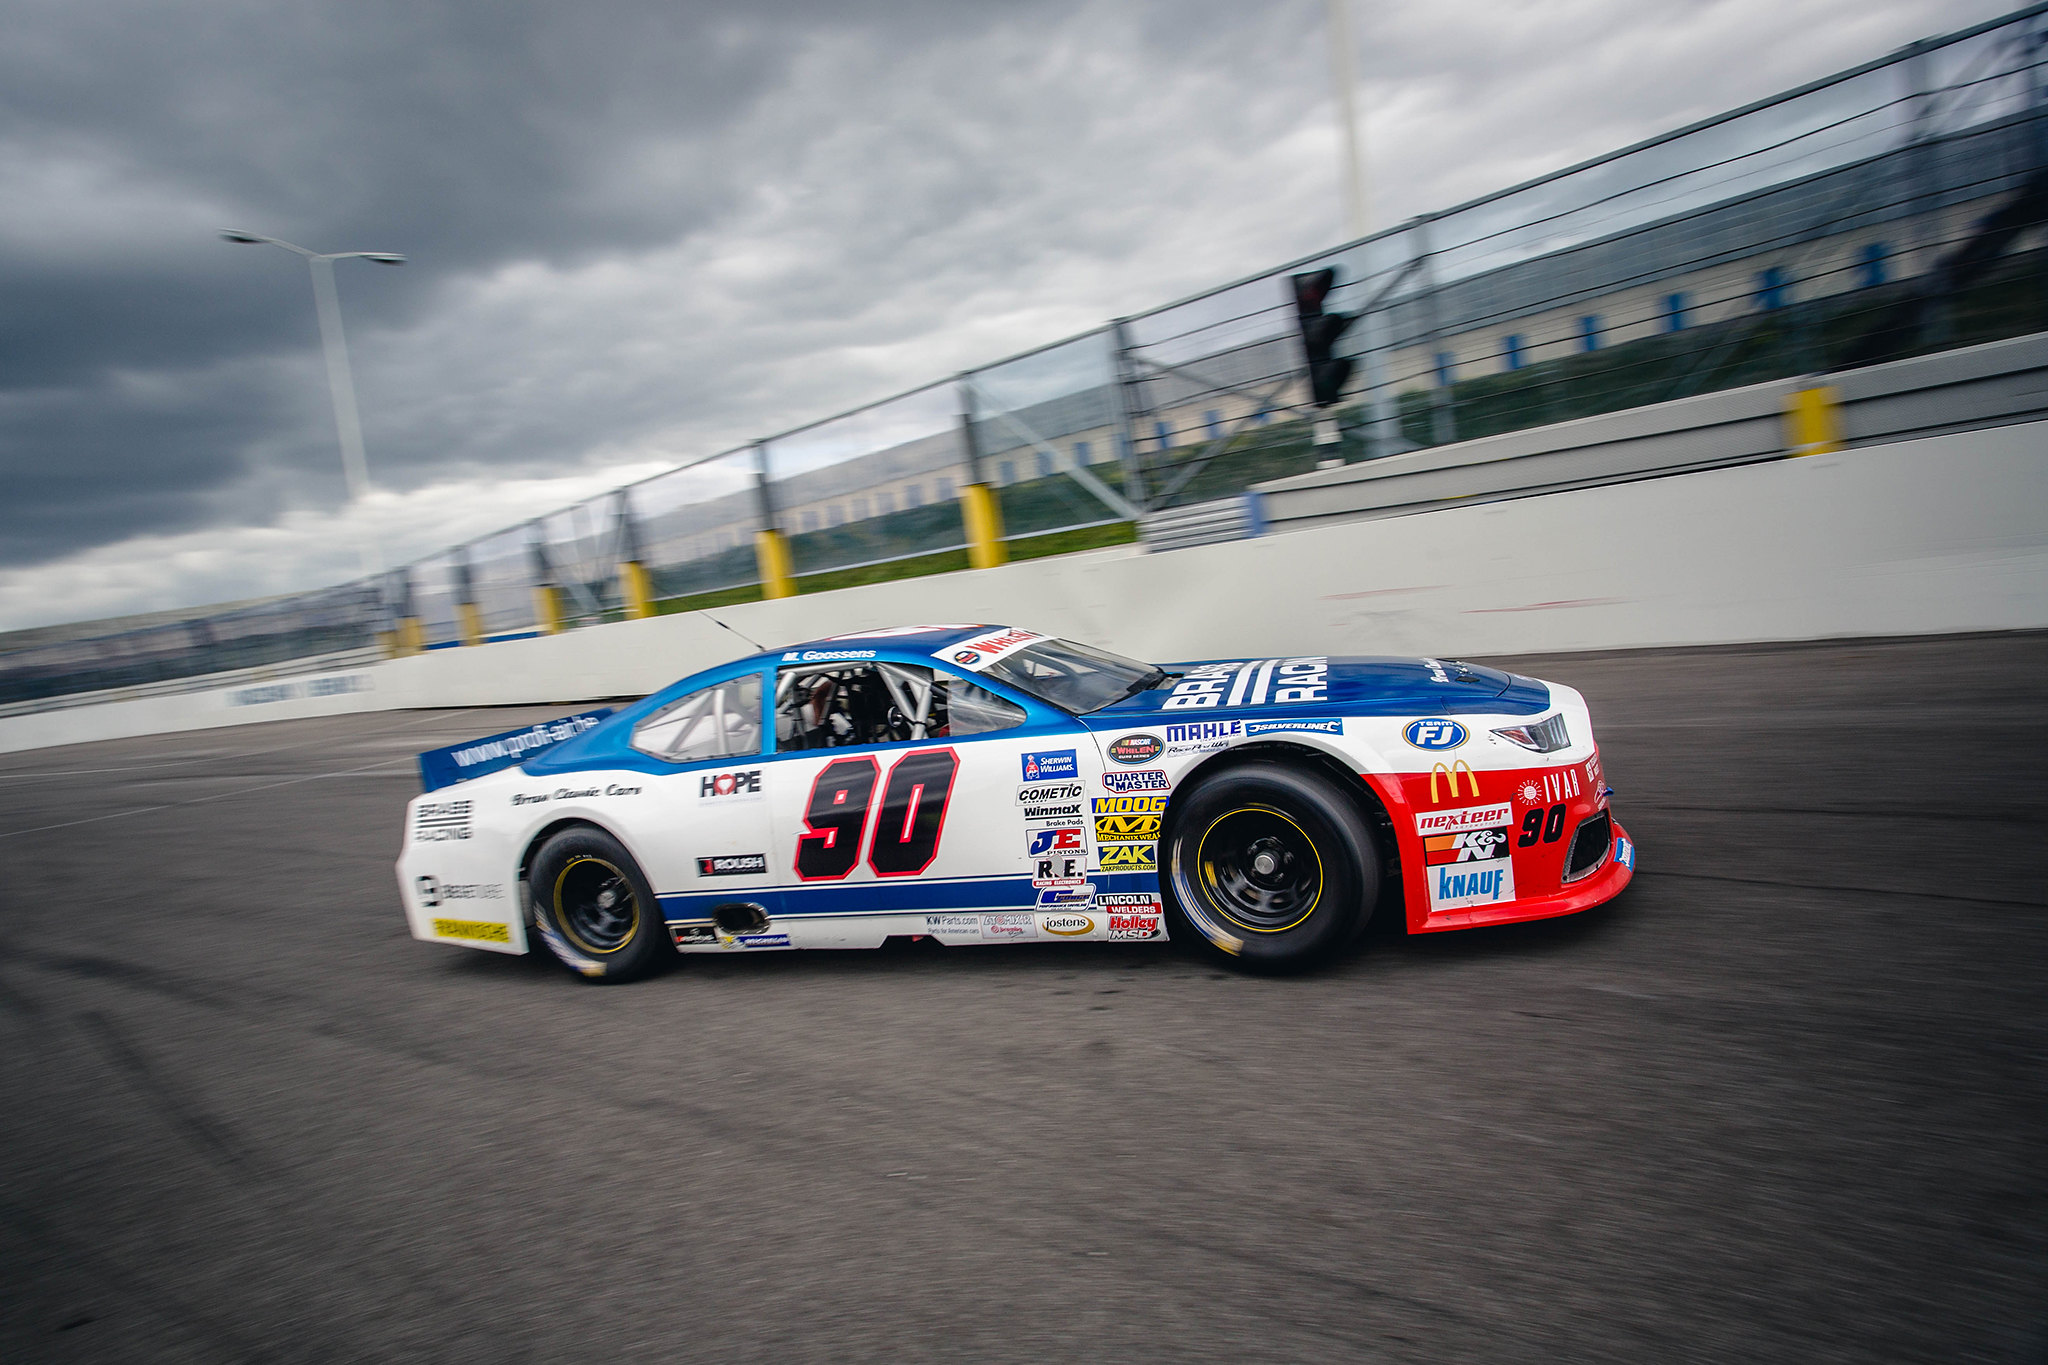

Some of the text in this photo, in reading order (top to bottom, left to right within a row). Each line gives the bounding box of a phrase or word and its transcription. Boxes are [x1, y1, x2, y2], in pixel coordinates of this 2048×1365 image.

[781, 649, 877, 662] M. Goossens
[1166, 720, 1242, 743] MAHLE
[1257, 720, 1330, 732] SILVERLINE
[1415, 726, 1454, 745] FJ
[1040, 756, 1072, 766] SHERWIN
[699, 770, 762, 798] HOPE
[1104, 771, 1164, 787] QUARTER
[1115, 779, 1167, 792] MASTER
[1543, 768, 1581, 803] IVAR
[1018, 783, 1083, 801] COMETIC
[1023, 804, 1082, 817] Winmax
[1094, 796, 1167, 813] MOOG
[792, 746, 961, 882] 90
[1419, 807, 1509, 831] nexteer
[1517, 803, 1567, 848] 90
[1029, 828, 1082, 856] JE
[1096, 833, 1139, 841] MECHANIX
[713, 856, 764, 871] ROUSH
[1101, 864, 1156, 872] ZAKPRODUCTS.COM
[1099, 895, 1150, 906] LINCOLN
[1111, 905, 1157, 914] WELDERS
[1046, 916, 1086, 931] jostens
[1109, 915, 1158, 933] Holley
[1110, 929, 1153, 939] MSD
